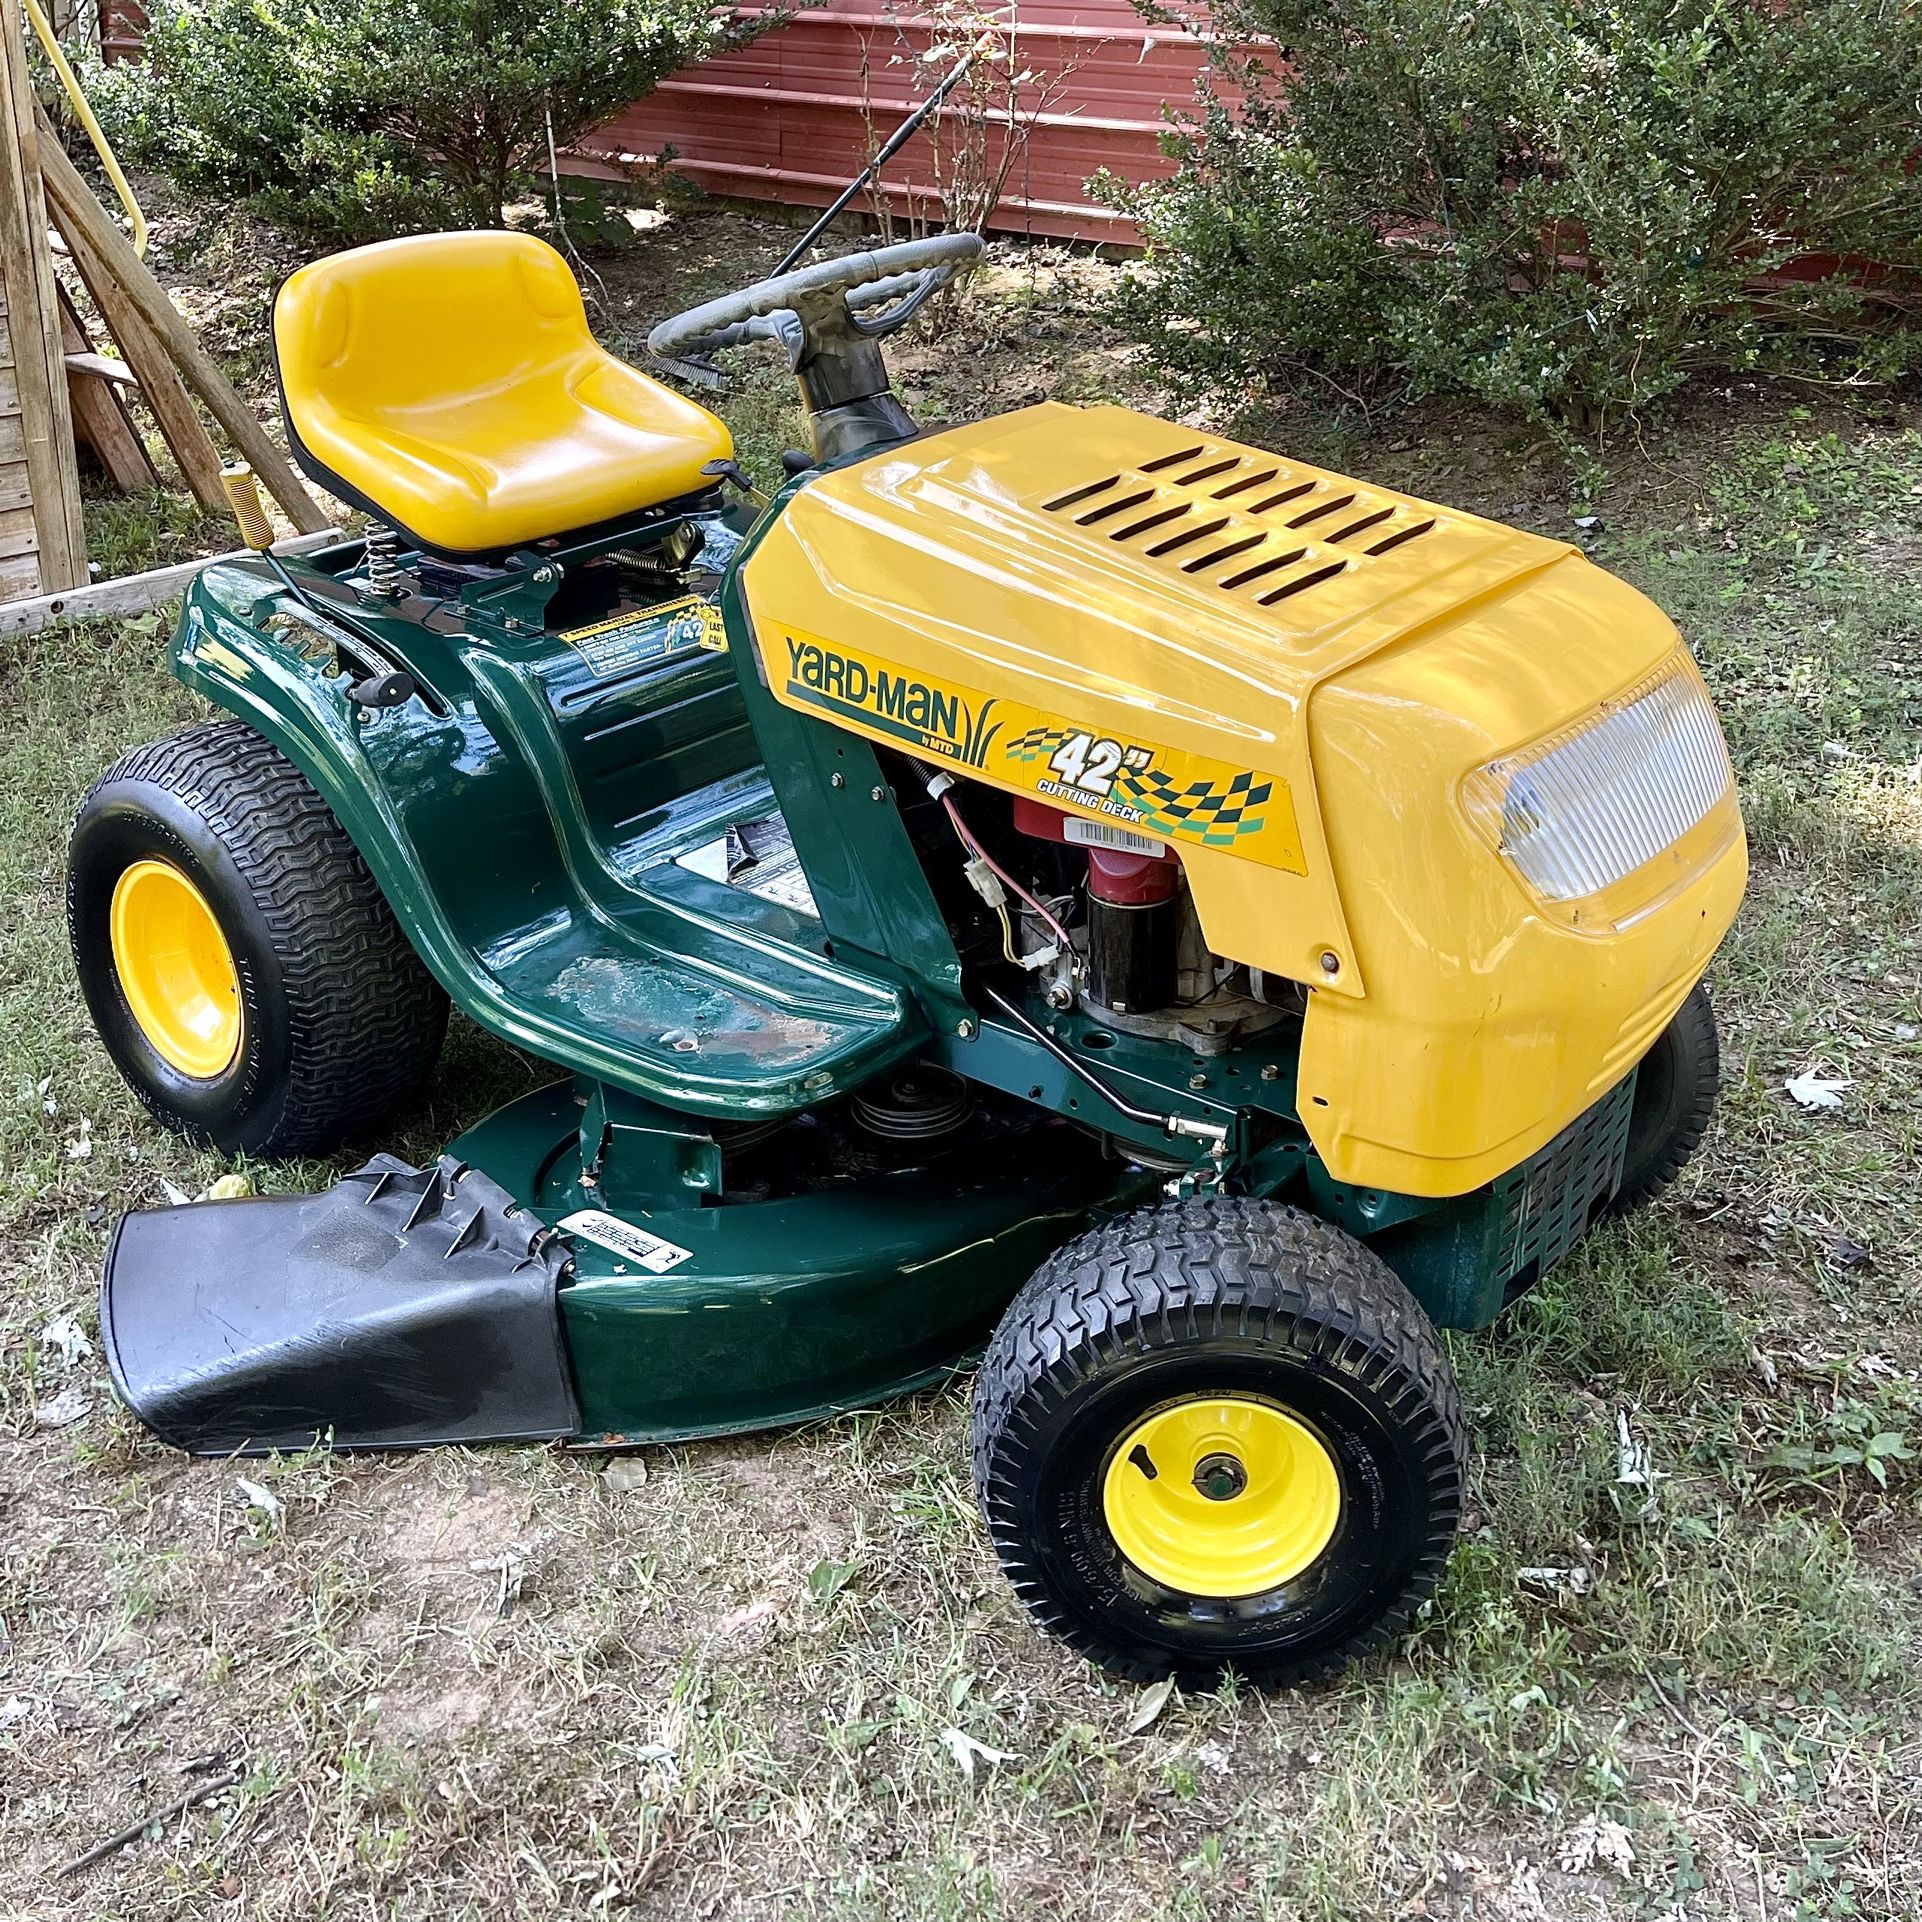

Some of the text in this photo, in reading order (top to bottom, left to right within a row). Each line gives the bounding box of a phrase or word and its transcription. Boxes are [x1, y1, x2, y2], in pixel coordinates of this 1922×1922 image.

[709, 621, 724, 633] LAST
[921, 734, 954, 755] by MTD
[1036, 779, 1146, 824] CUTTING DECK
